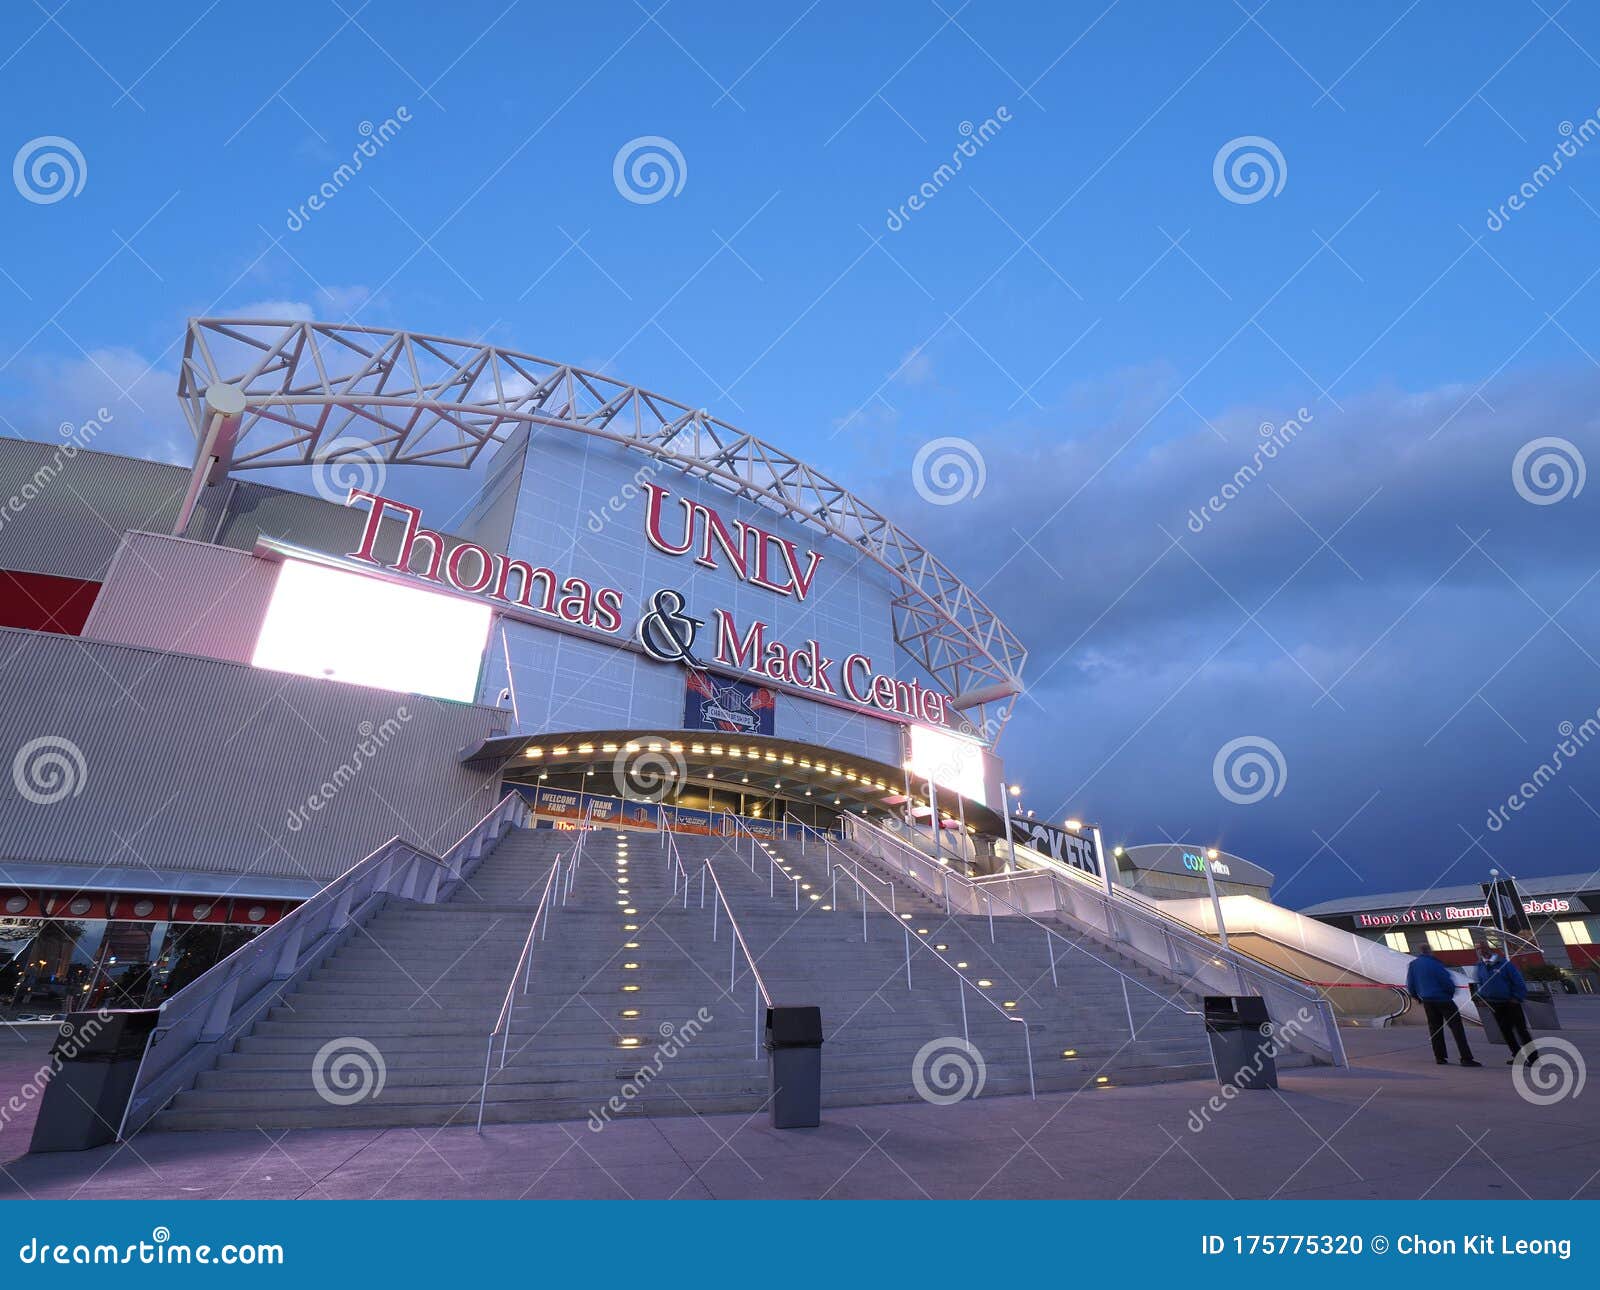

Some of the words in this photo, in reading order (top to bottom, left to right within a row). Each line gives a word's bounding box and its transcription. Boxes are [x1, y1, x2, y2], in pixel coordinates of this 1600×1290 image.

[642, 481, 825, 601] UNLV
[346, 487, 624, 633] Thomas
[636, 588, 709, 670] &
[712, 608, 837, 696] Mack
[843, 653, 954, 727] Center
[542, 793, 577, 805] WELCOME
[1183, 853, 1206, 872] COX
[1360, 914, 1399, 926] Home
[1403, 909, 1417, 923] of
[1420, 908, 1442, 921] the
[1445, 903, 1493, 920] Runni
[1522, 898, 1570, 914] ebels
